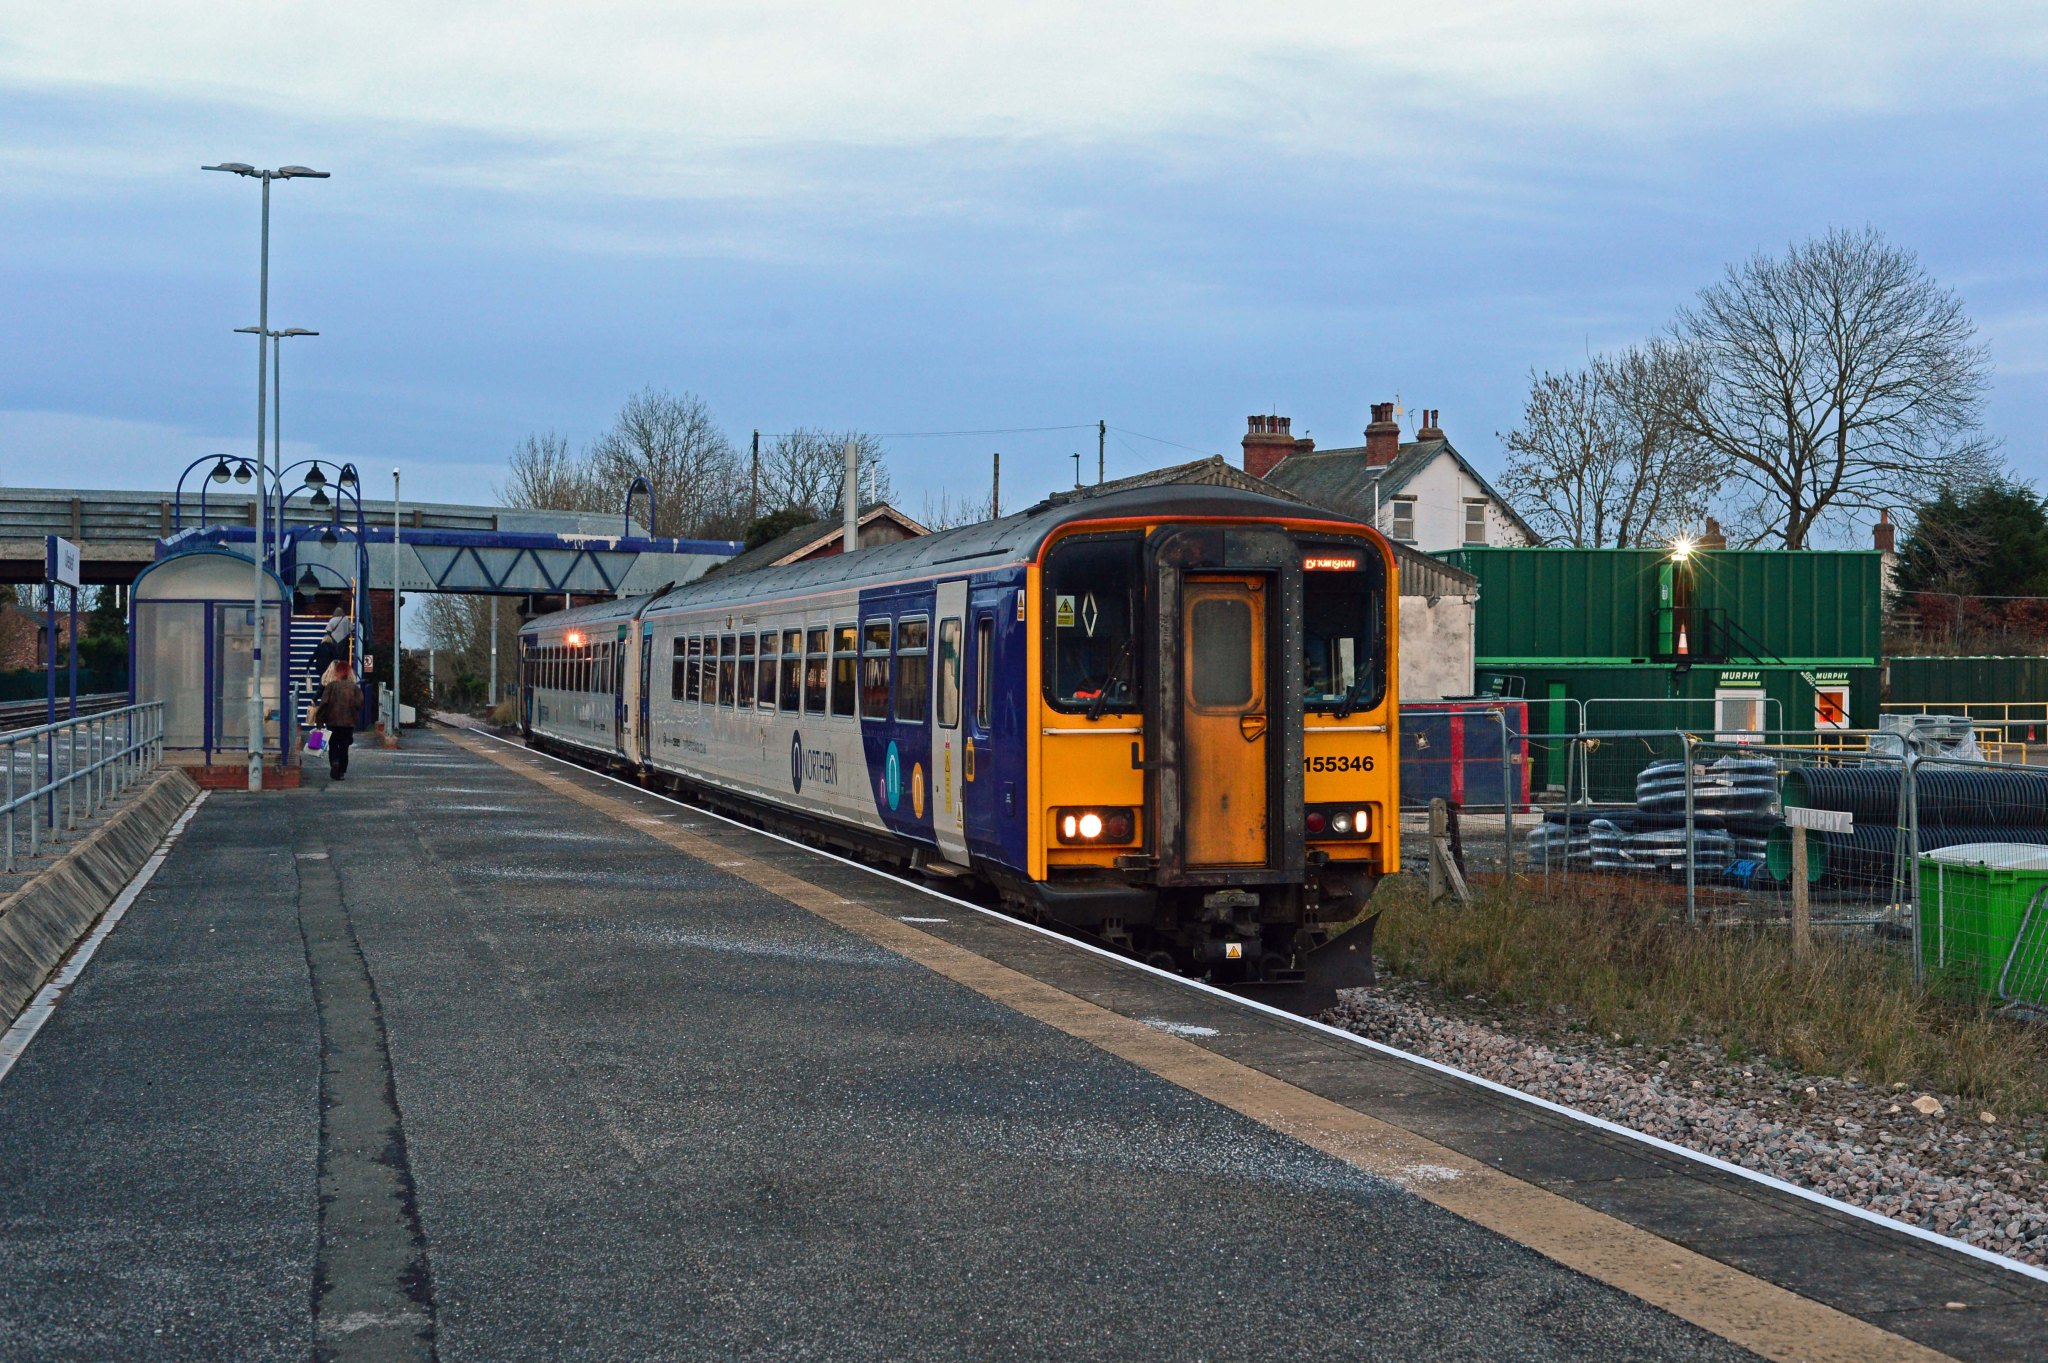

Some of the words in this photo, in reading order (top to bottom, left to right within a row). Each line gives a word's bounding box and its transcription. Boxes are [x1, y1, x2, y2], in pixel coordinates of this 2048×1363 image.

[1721, 671, 1760, 680] MURPHY
[1816, 672, 1848, 680] MURPHY
[802, 748, 838, 786] NORTHERN
[1303, 755, 1374, 772] 155346
[1791, 808, 1842, 831] MURPHY
